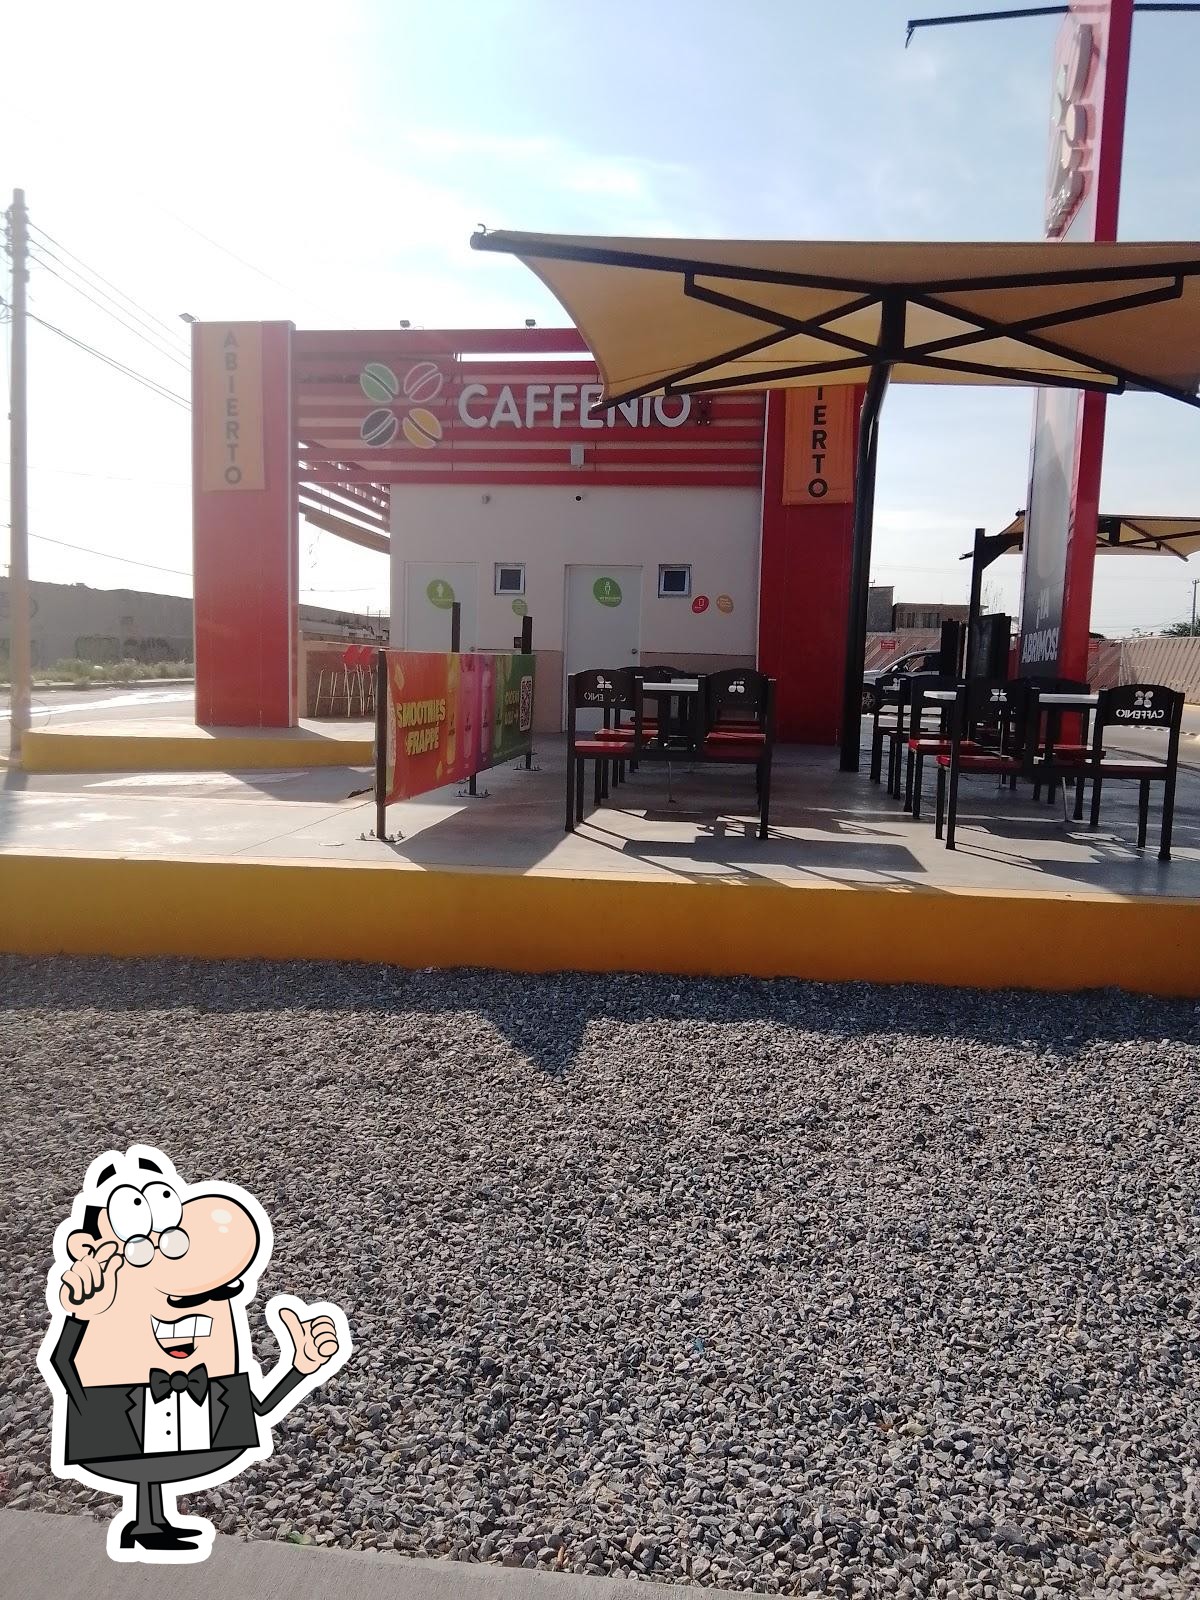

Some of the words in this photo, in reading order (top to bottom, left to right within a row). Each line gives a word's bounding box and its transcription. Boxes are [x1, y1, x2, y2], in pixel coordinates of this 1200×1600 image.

[224, 329, 242, 486] ABIERTO
[458, 383, 692, 429] CAFFENIO
[808, 385, 828, 498] IERTO
[396, 699, 446, 728] SMOOTHIES
